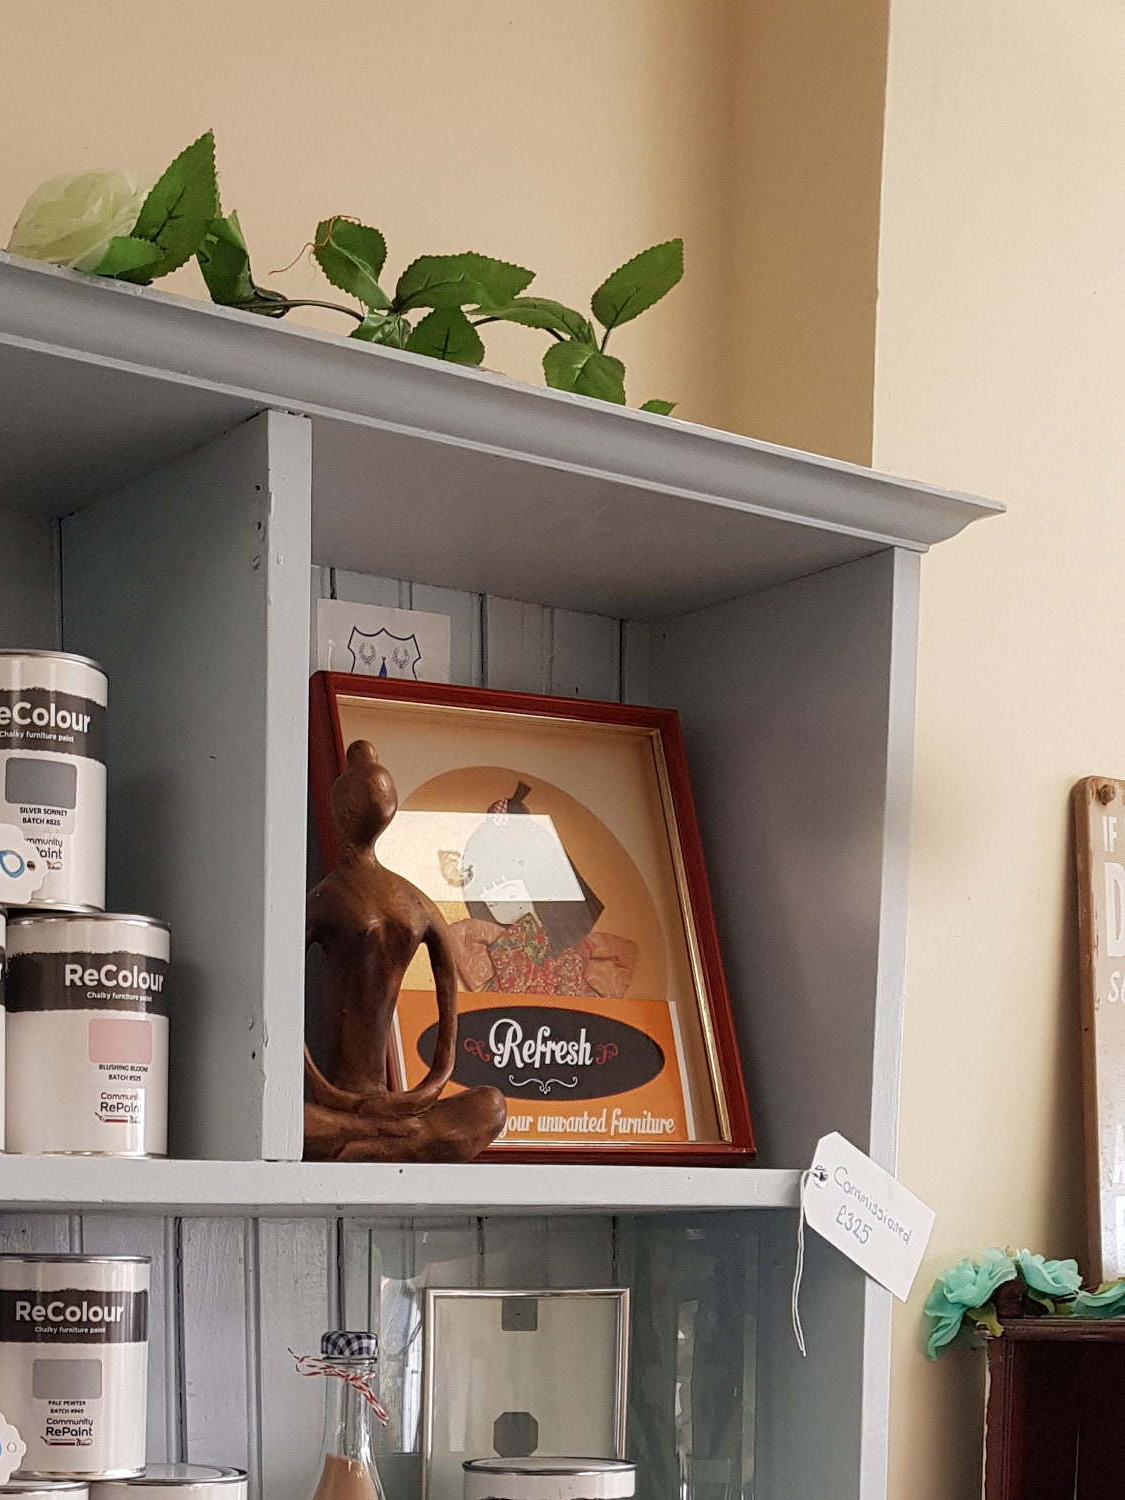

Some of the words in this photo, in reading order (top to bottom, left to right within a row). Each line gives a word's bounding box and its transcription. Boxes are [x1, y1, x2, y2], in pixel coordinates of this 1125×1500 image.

[26, 731, 57, 741] furniture
[43, 808, 67, 816] SONNET
[65, 964, 164, 992] ReColour
[87, 992, 111, 1000] Chalky
[112, 992, 139, 1001] furniture
[489, 1019, 594, 1069] Refresh
[99, 1064, 129, 1072] BLUSHING
[537, 1109, 608, 1133] unwanted
[610, 1108, 675, 1135] furniture
[836, 1205, 873, 1244] £325
[15, 1301, 123, 1323] ReColour
[35, 1326, 57, 1334] Chalky
[46, 1418, 93, 1426] Community
[46, 1427, 93, 1437] RePaint
